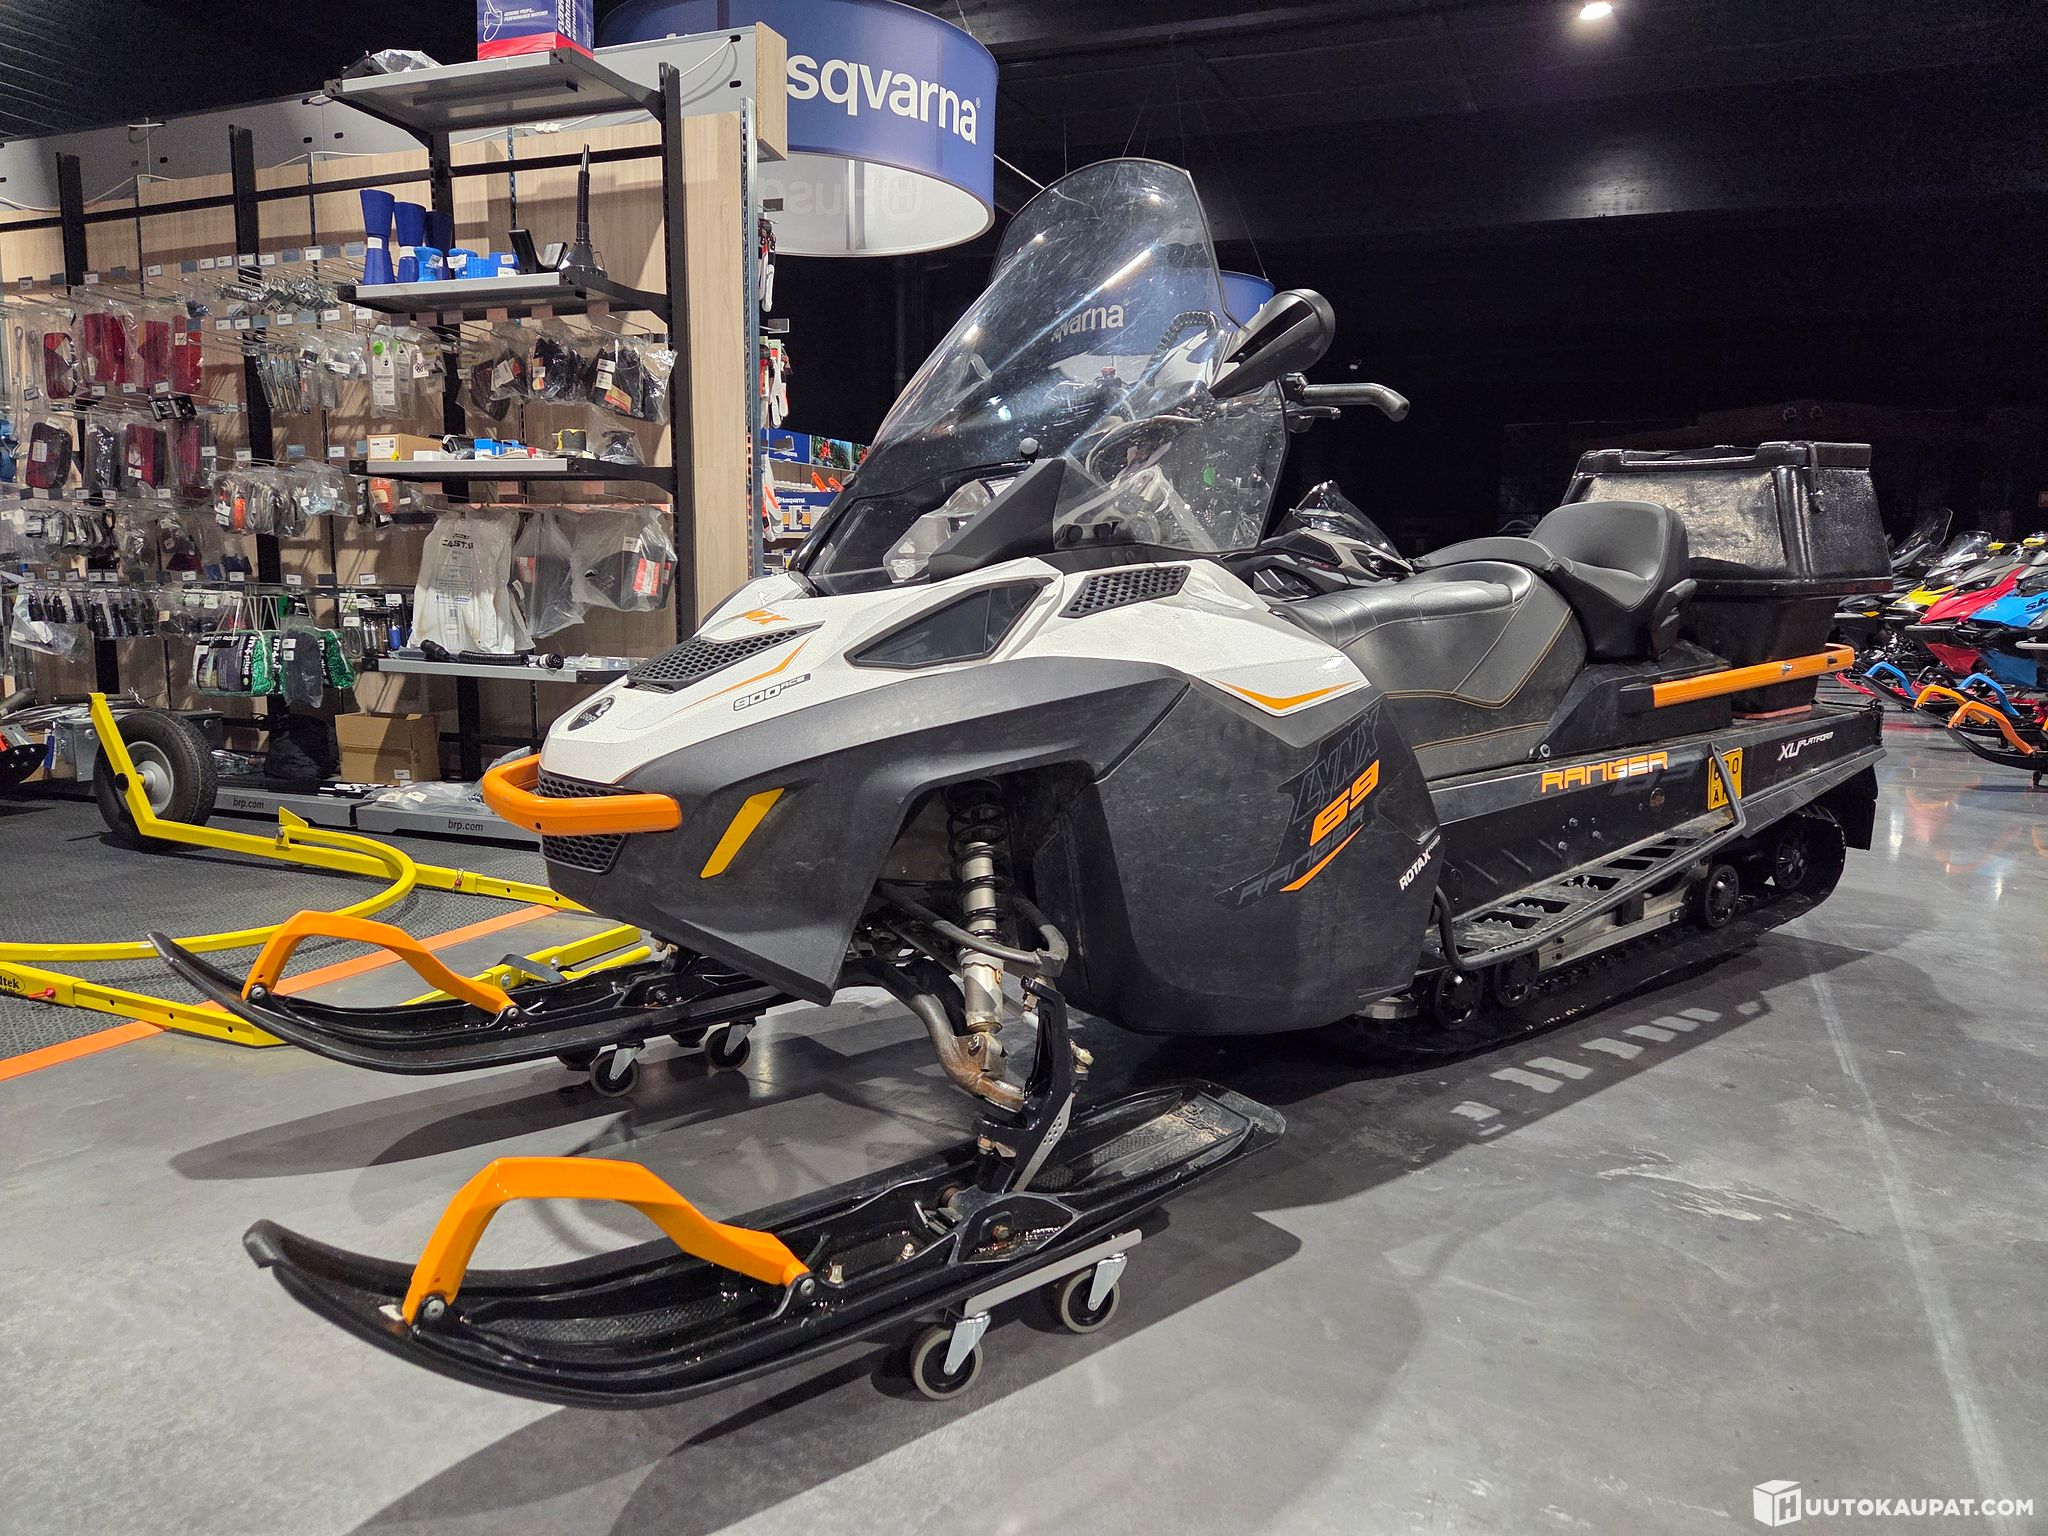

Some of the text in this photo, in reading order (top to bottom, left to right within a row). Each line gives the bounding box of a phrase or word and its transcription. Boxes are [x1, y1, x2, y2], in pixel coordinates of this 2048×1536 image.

[787, 55, 977, 145] sqvarna
[1050, 303, 1125, 344] qvarna
[733, 684, 782, 712] 900
[1292, 703, 1381, 825] LYNX
[1540, 751, 1669, 794] RANGER
[232, 795, 265, 809] brp.com
[1310, 759, 1380, 847] 69
[447, 819, 484, 832] brp.com
[1236, 804, 1365, 906] RANGER
[1398, 848, 1432, 891] ROTAX
